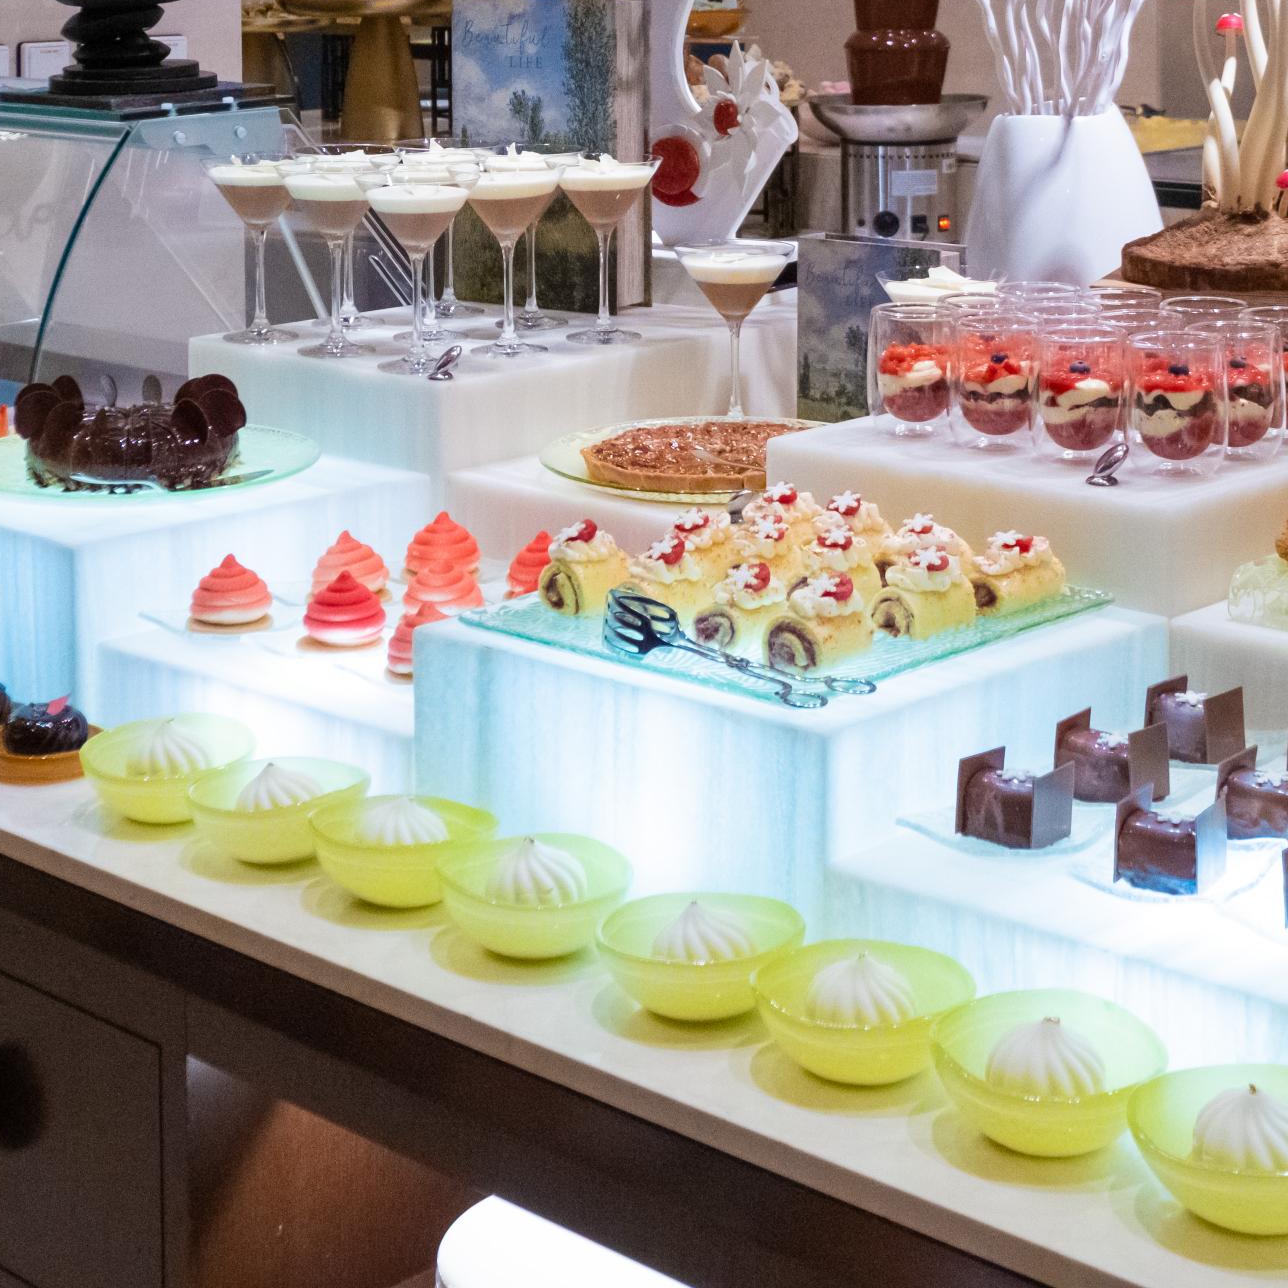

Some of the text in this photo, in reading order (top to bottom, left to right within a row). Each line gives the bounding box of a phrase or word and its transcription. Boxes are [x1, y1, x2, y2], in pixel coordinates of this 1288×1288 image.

[462, 18, 550, 54] Beautiful
[509, 55, 543, 69] LIFE
[804, 261, 876, 296] Beautifu
